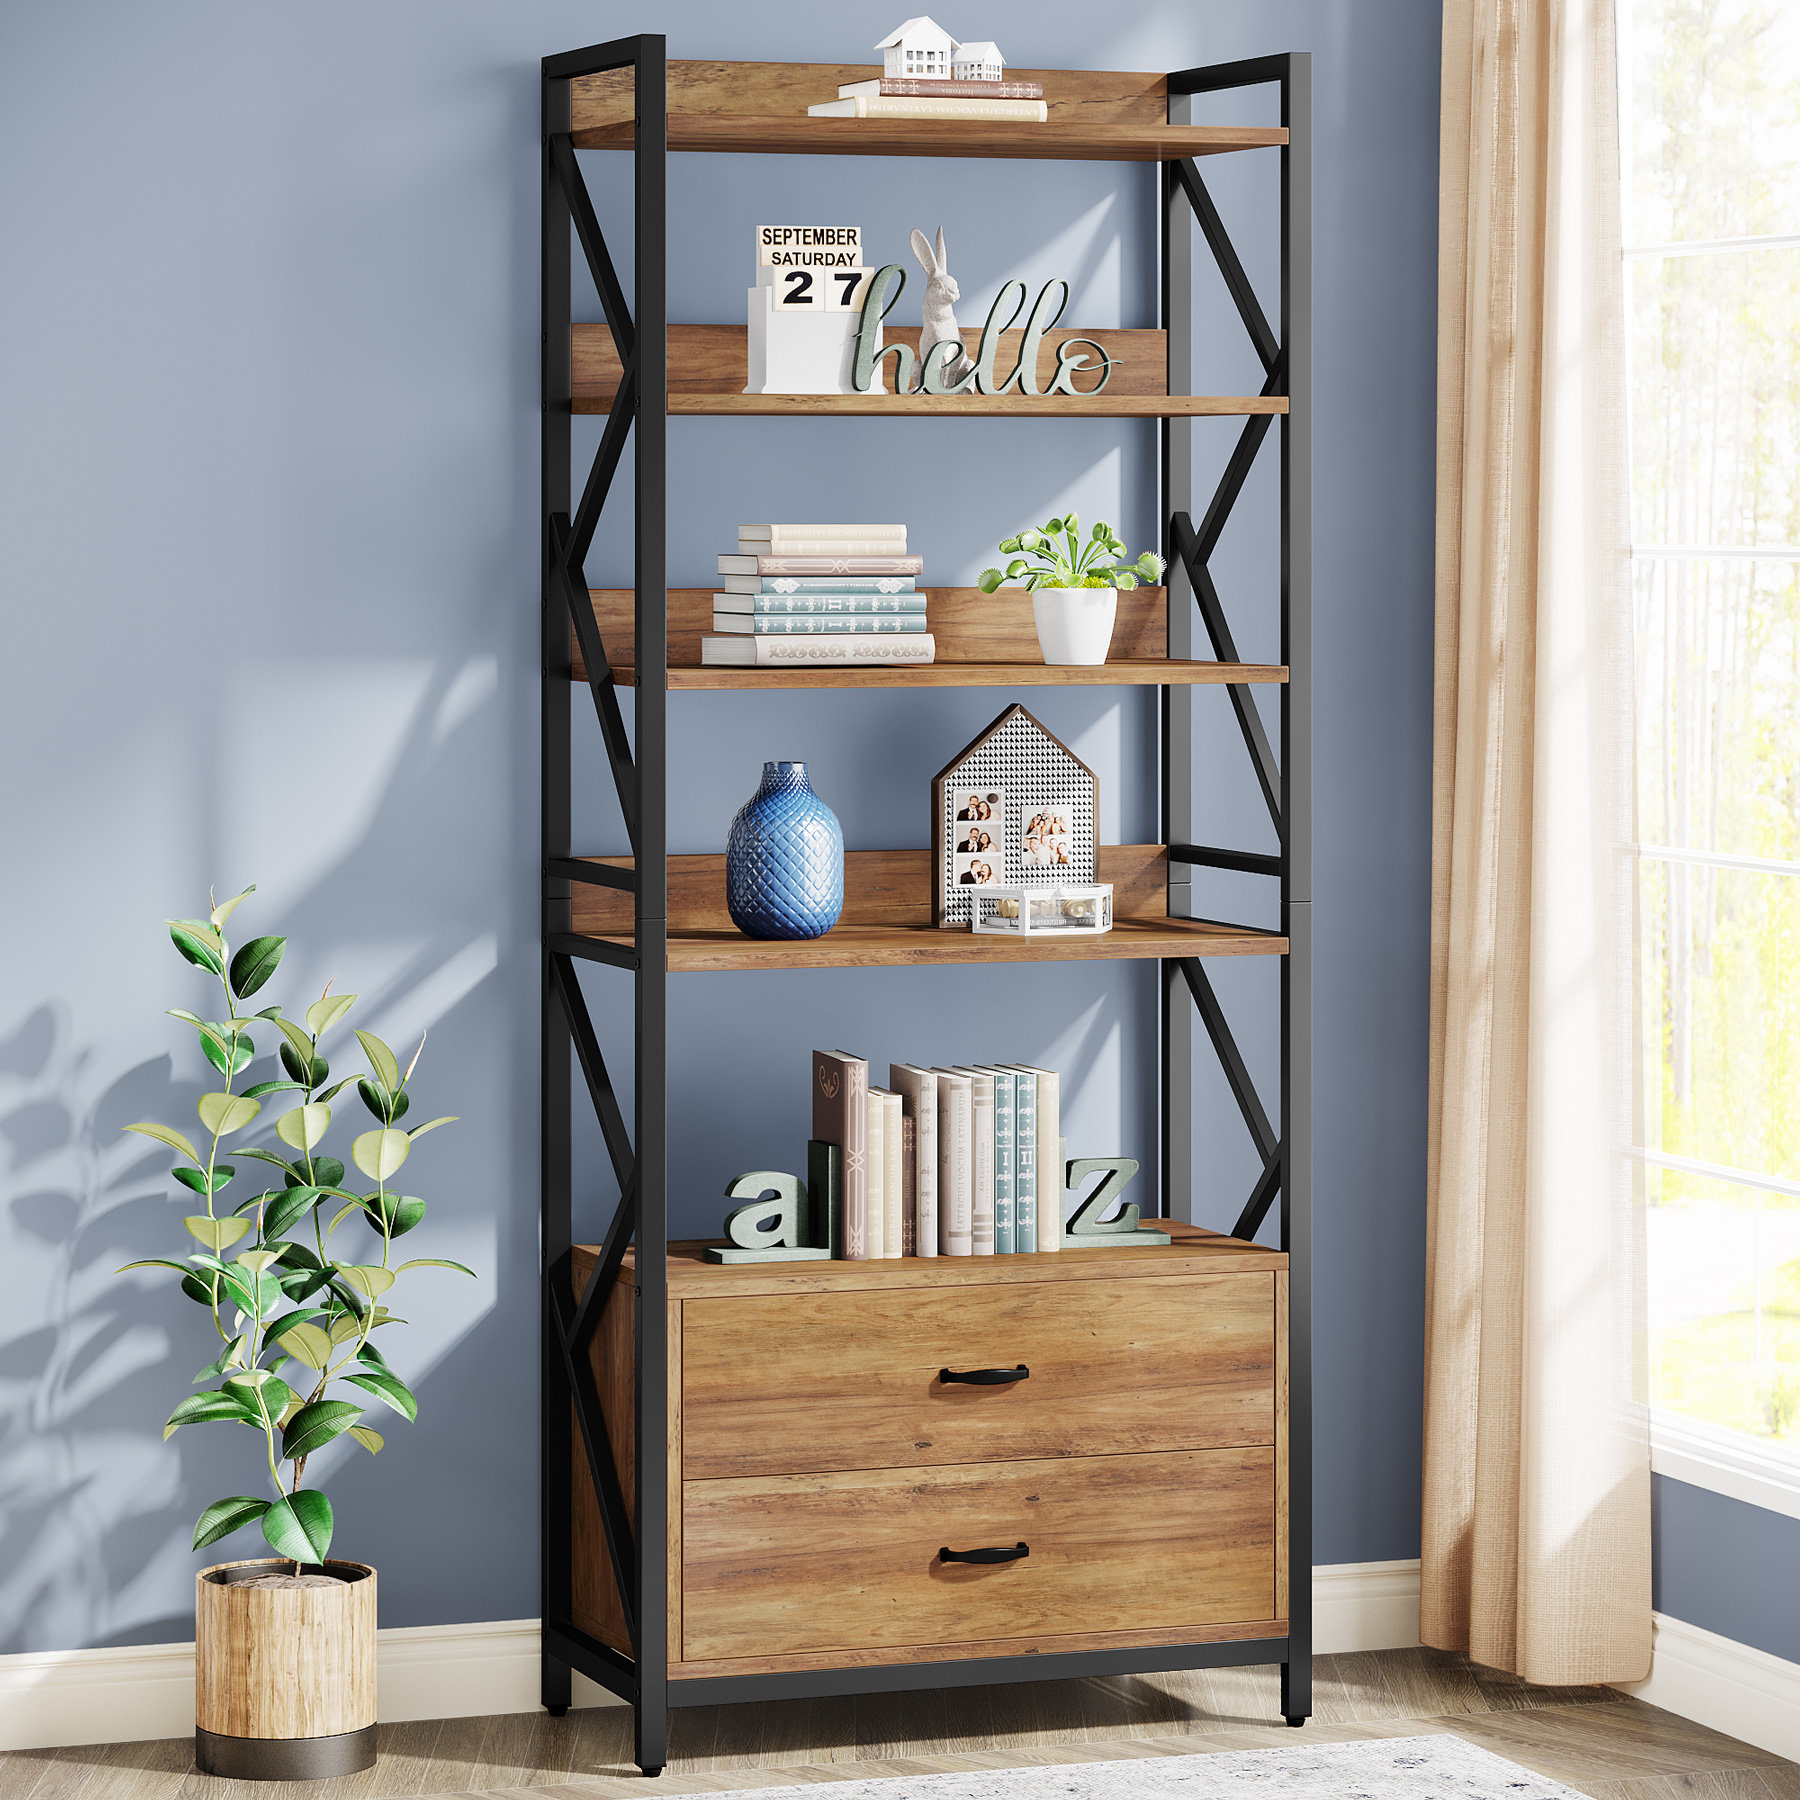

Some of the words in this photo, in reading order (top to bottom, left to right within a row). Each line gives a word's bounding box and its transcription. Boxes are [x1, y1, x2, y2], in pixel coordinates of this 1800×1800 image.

[762, 228, 857, 245] SEPTEMBER
[772, 252, 856, 266] SATURDAY
[852, 264, 1124, 395] hello
[958, 1092, 966, 1143] LATINARUM
[958, 1146, 966, 1180] VOCUM
[1002, 1151, 1009, 1166] I
[1020, 1151, 1033, 1165] II
[723, 1170, 804, 1250] a
[1065, 1157, 1139, 1234] z
